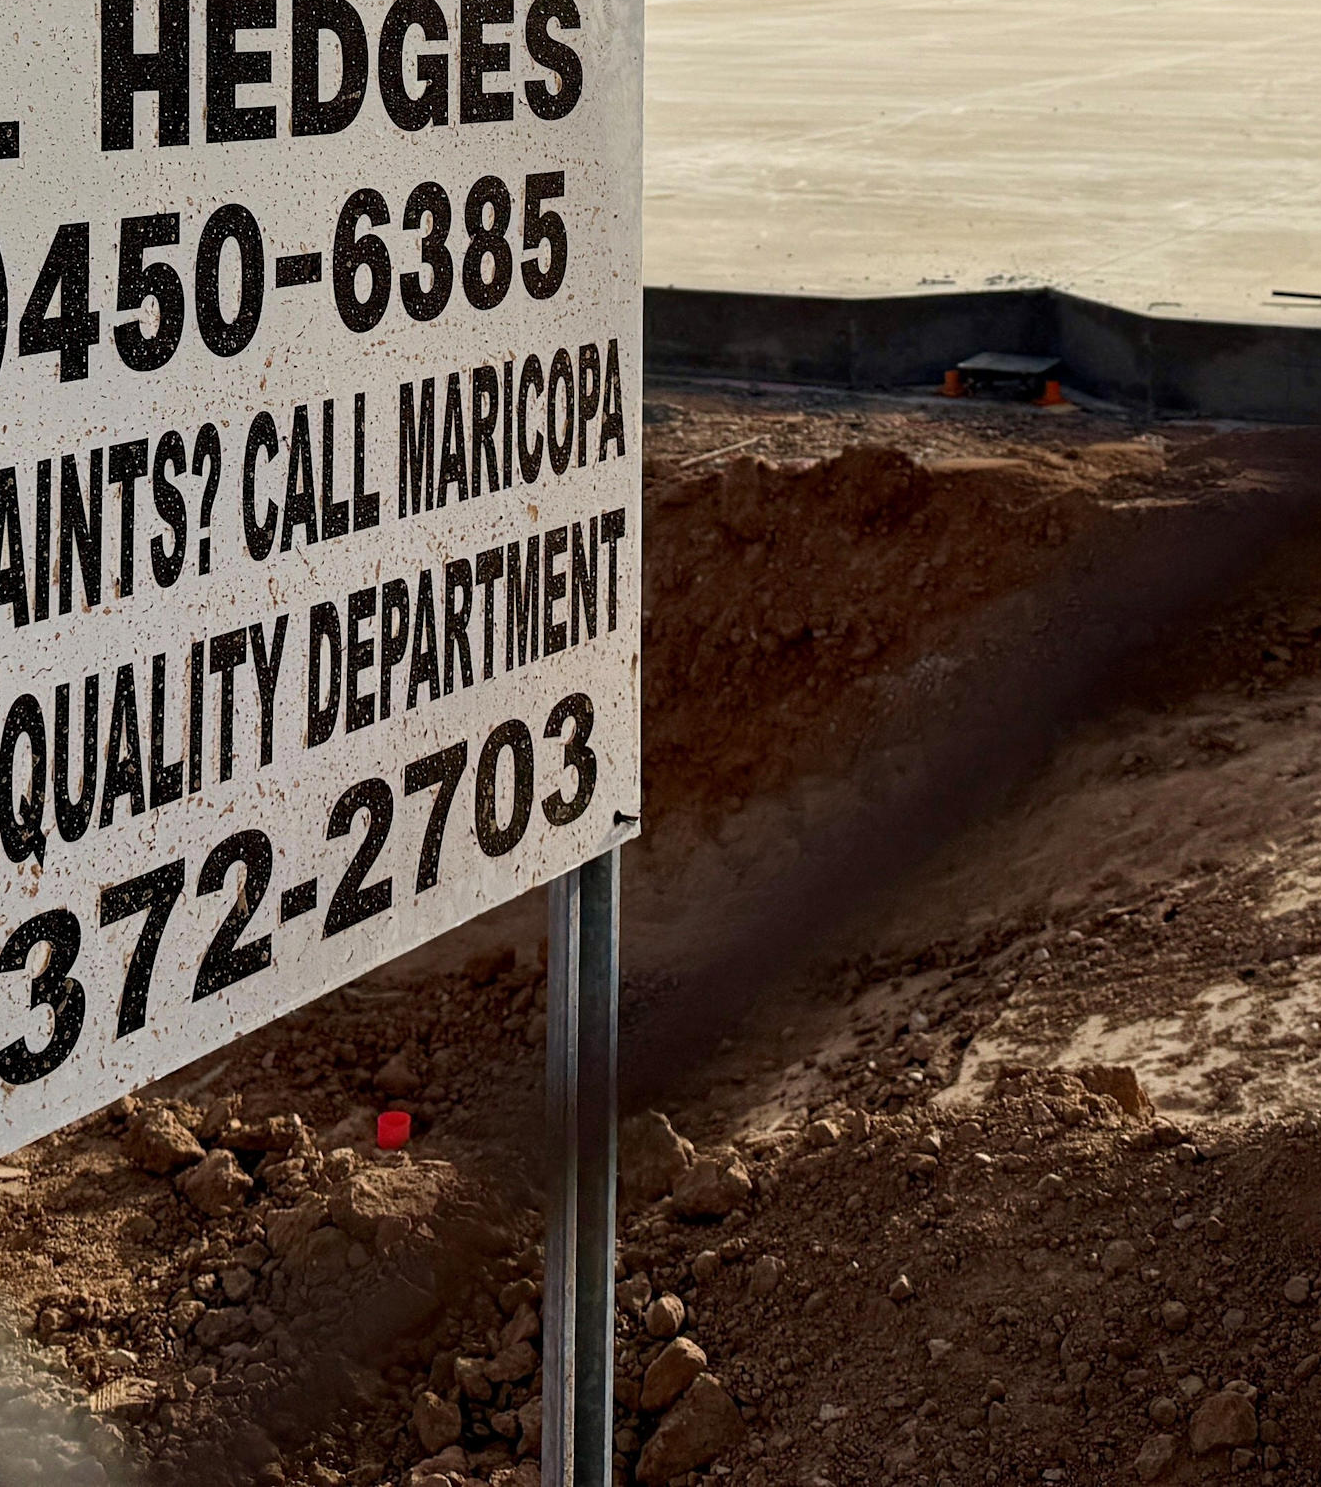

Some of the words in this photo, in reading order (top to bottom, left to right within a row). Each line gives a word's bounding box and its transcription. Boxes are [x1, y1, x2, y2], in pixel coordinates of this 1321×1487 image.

[243, 392, 379, 561] CALL
[398, 338, 625, 520] MARICOPA
[306, 507, 627, 750] DEPARTMENT
